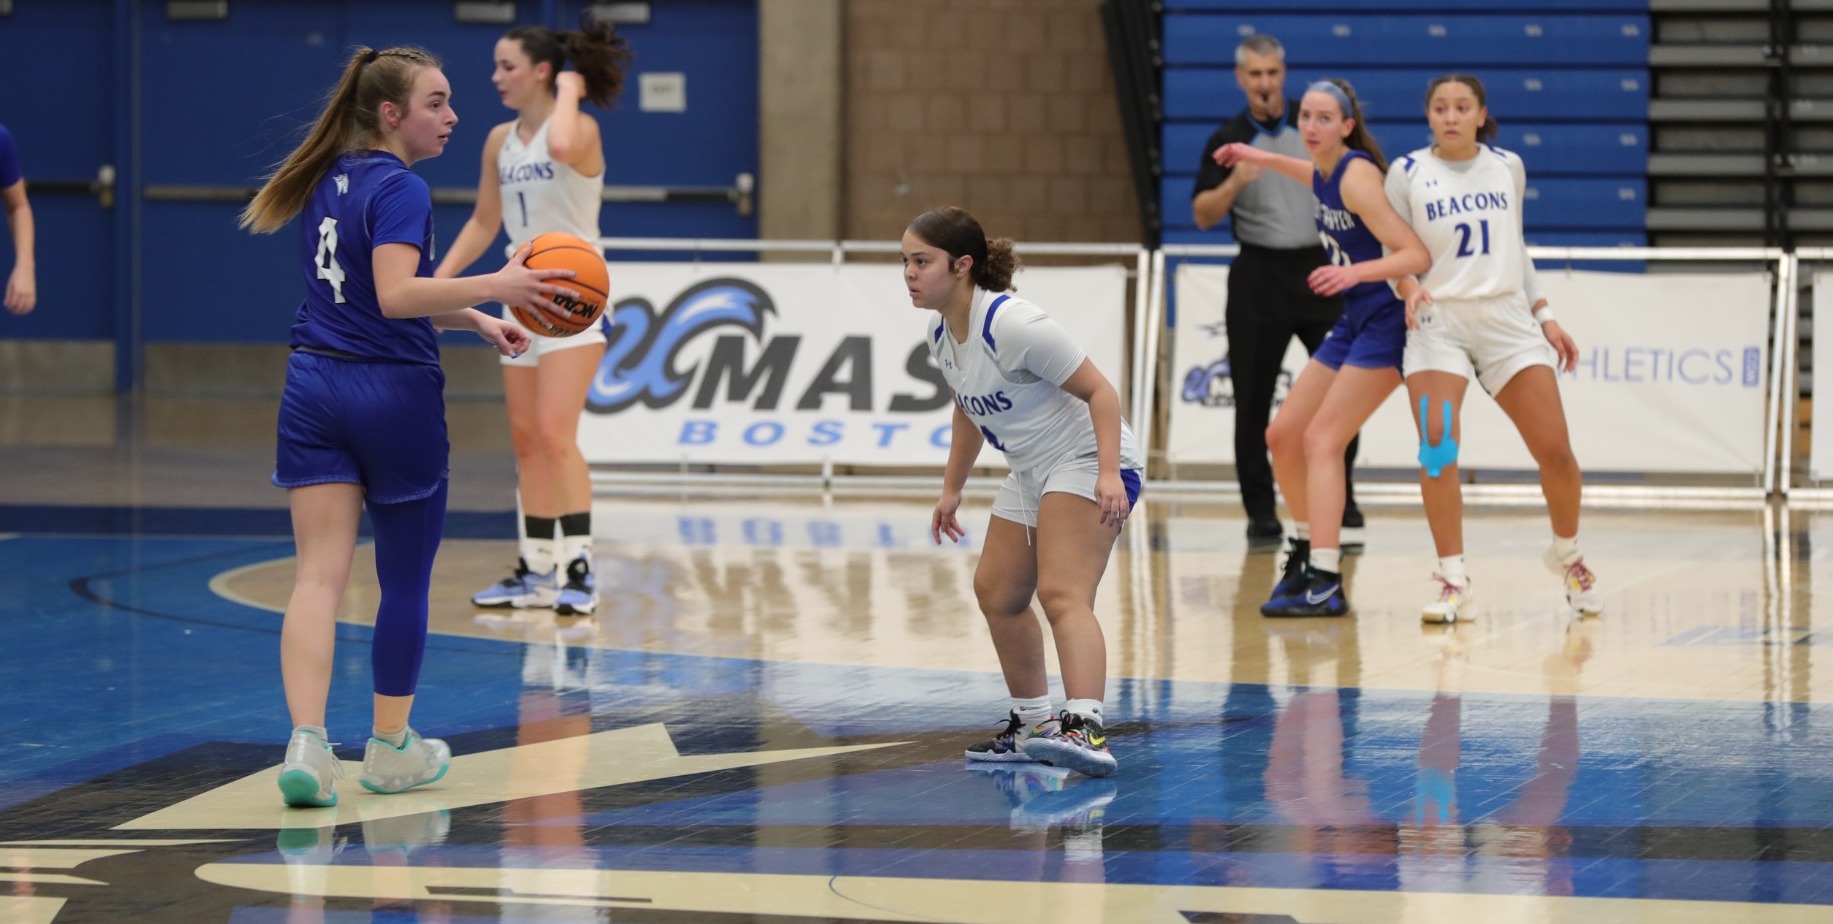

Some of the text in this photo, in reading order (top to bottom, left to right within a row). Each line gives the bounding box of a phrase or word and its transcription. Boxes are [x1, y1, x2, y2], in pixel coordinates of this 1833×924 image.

[517, 190, 528, 227] 1
[1425, 191, 1507, 222] BEACONS
[1454, 219, 1490, 259] 21
[315, 216, 346, 304] 4
[583, 276, 953, 416] UMAS
[1574, 346, 1734, 386] HLETICS
[677, 419, 952, 448] BOSTO
